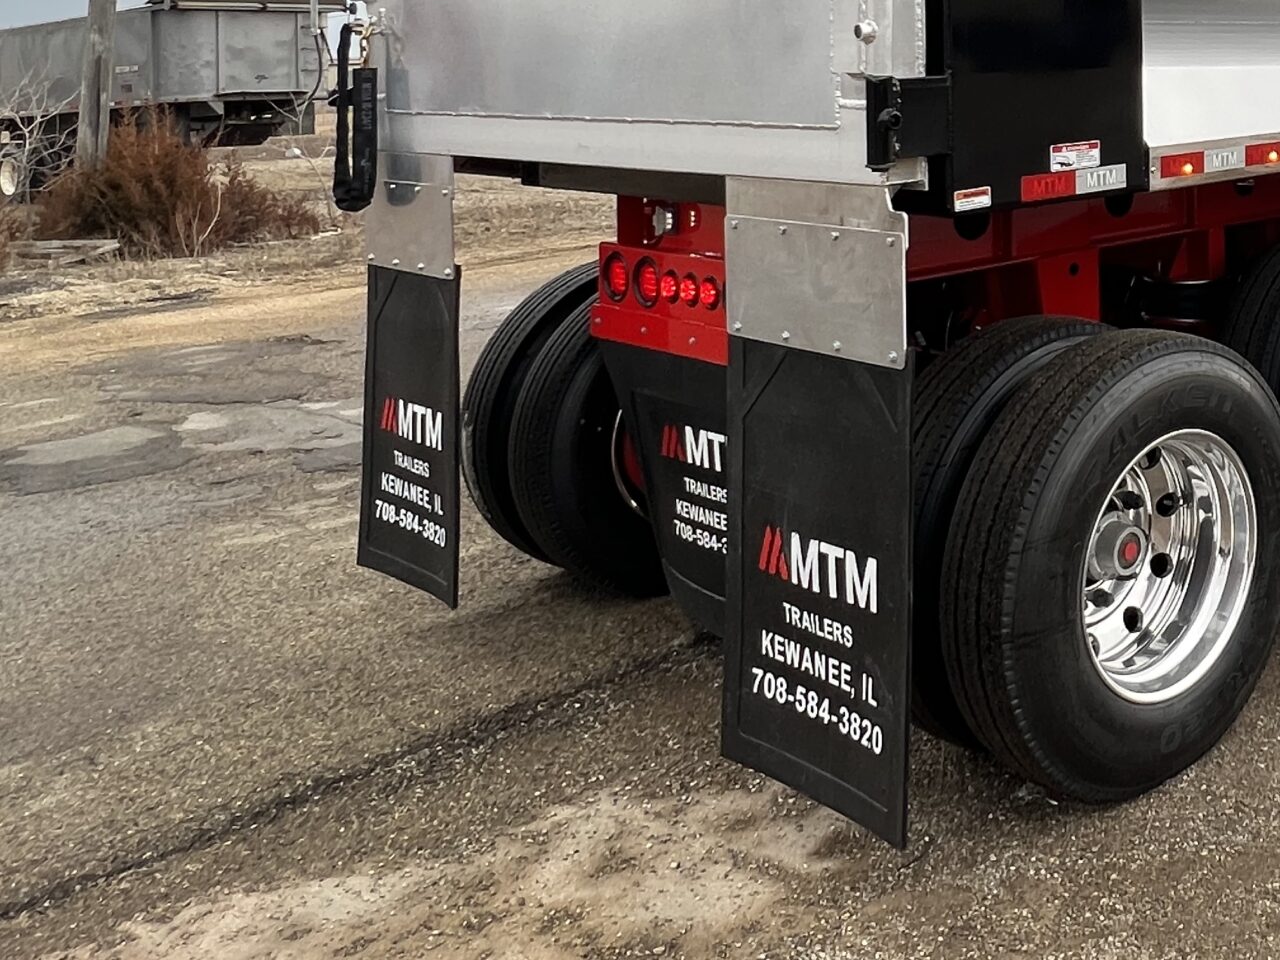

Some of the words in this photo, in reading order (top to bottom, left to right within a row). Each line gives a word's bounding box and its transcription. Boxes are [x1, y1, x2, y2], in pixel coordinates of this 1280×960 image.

[1033, 176, 1066, 196] MTM
[1087, 168, 1117, 188] MTM
[1212, 151, 1237, 168] MTM
[398, 398, 443, 451] MTM
[393, 449, 430, 478] TRAILERS
[381, 471, 432, 513] KEWANEE,
[434, 493, 444, 516] IL
[374, 499, 446, 548] 708-584-3820
[790, 531, 878, 614] MTM
[783, 601, 854, 648] TRAILERS
[761, 629, 856, 700] KEWANEE,
[861, 672, 878, 708] IL
[751, 667, 883, 756] 708-584-3820
